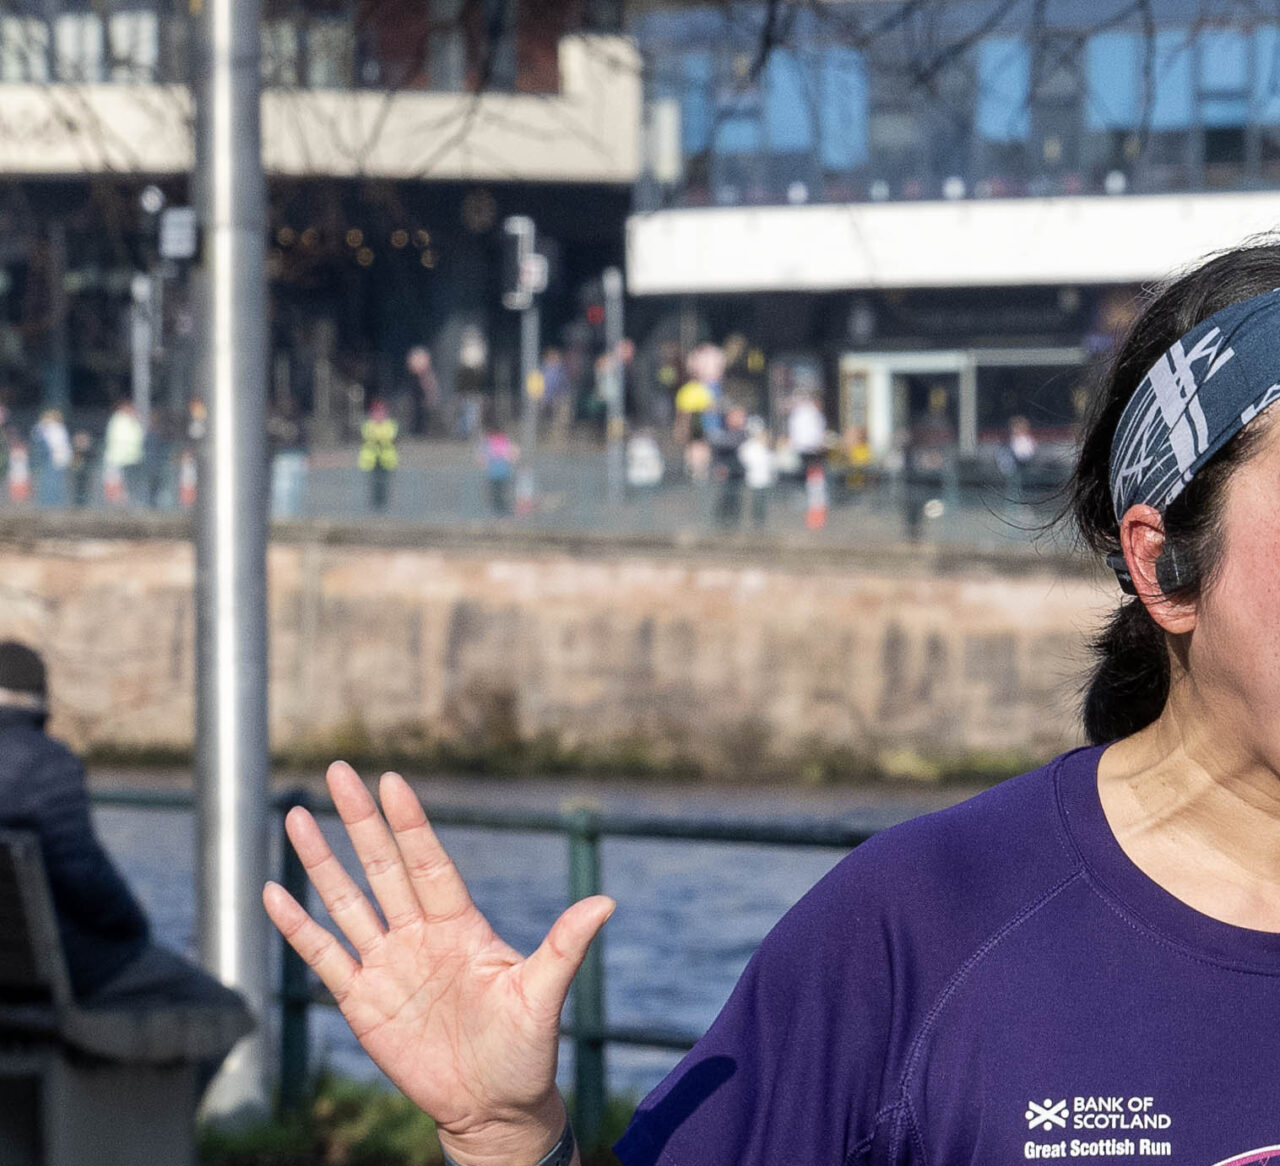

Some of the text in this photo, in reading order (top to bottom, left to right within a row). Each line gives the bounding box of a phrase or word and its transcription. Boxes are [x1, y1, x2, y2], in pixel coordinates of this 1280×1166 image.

[1073, 1097, 1154, 1112] BANK OF
[1073, 1114, 1172, 1129] SCOTLAND
[1024, 1138, 1172, 1159] Great Scottish Run
